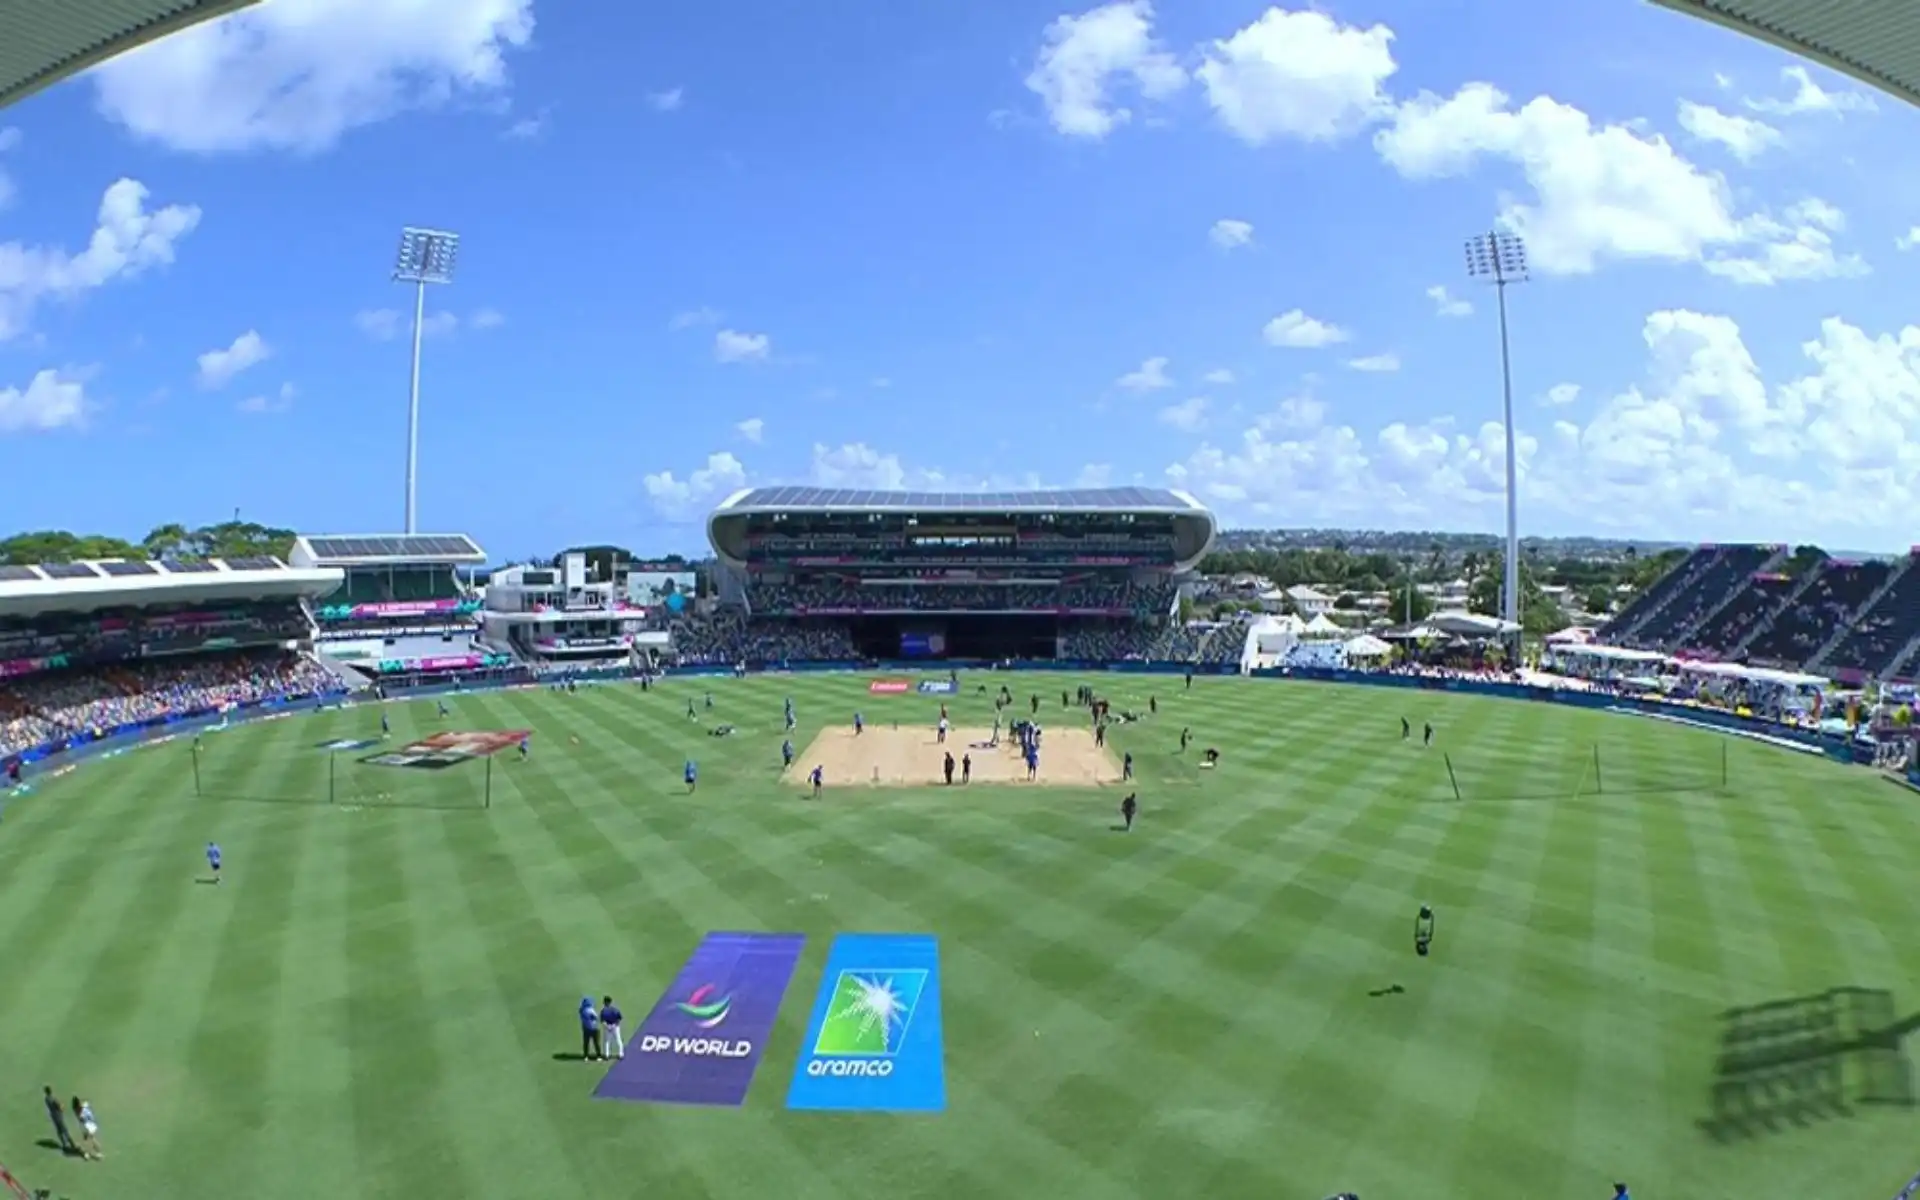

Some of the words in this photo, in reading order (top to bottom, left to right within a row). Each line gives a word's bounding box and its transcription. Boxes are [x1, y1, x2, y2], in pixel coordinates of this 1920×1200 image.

[641, 1036, 671, 1051] DP
[674, 1039, 751, 1057] WORLD
[807, 1059, 892, 1076] aramco
